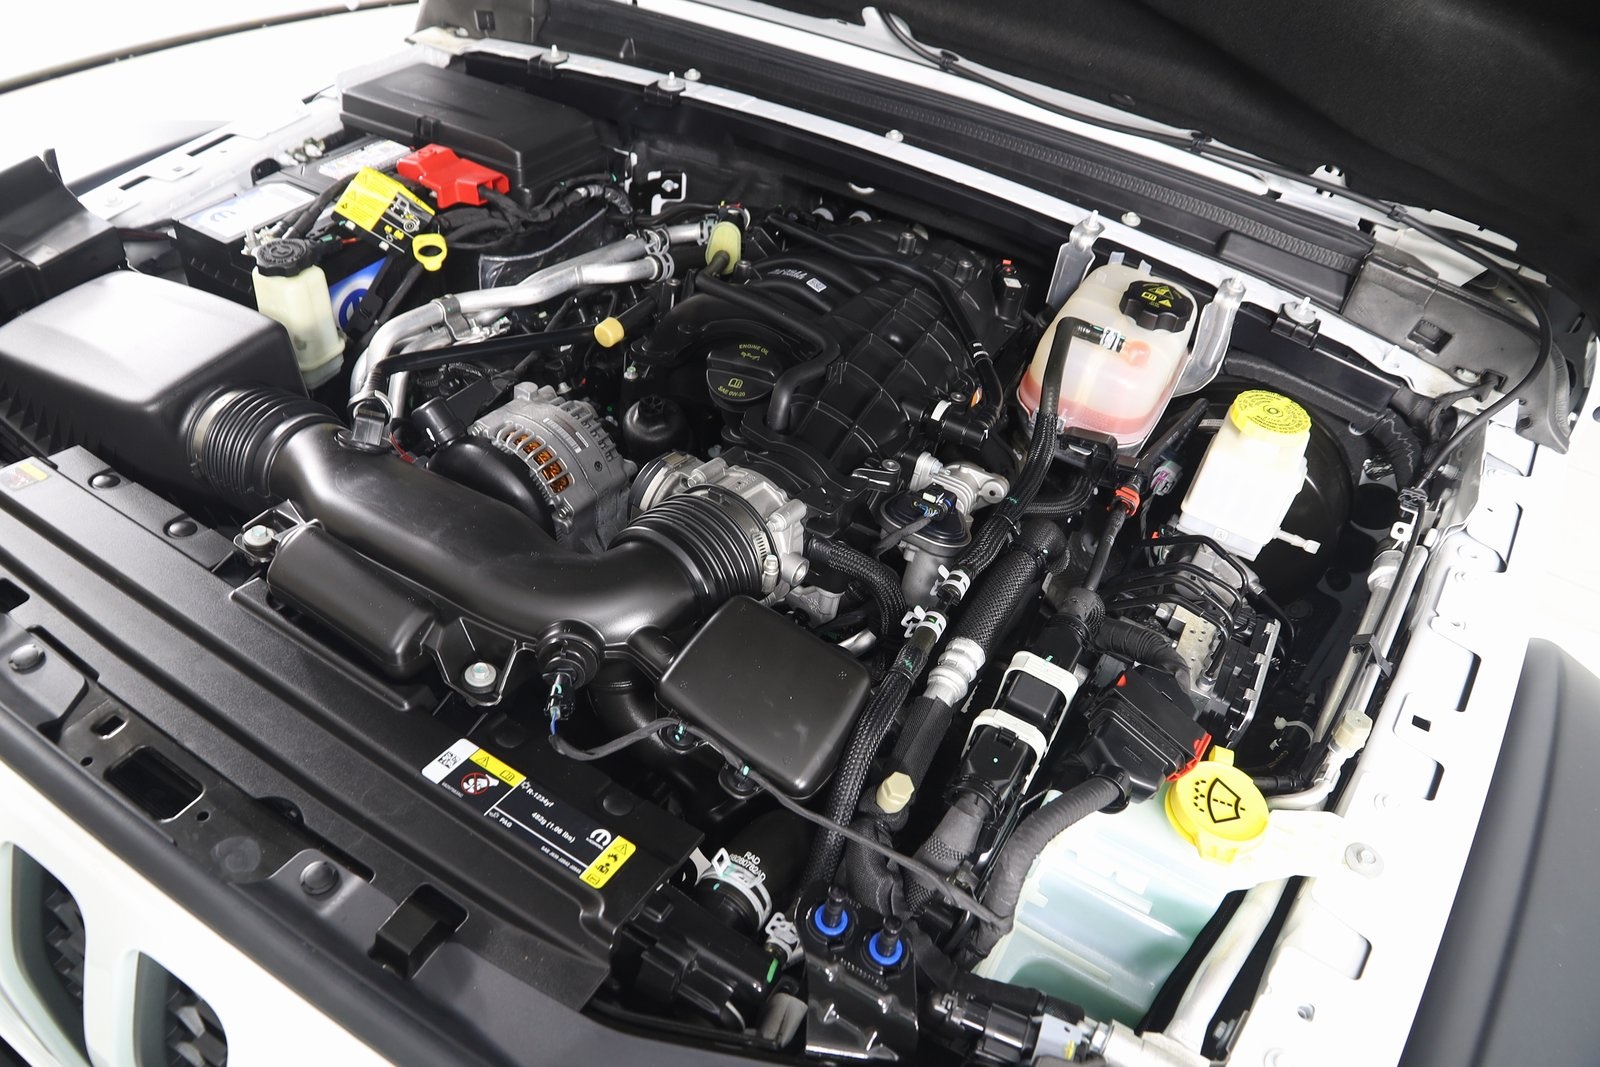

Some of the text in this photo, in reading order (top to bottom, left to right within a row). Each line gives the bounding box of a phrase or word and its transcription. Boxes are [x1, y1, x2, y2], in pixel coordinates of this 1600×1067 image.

[761, 347, 769, 356] OIL
[718, 386, 729, 396] SAE
[526, 788, 554, 807] R-1234yf
[499, 817, 513, 828] PAG
[562, 831, 576, 843] lbs)
[744, 851, 760, 865] RAD
